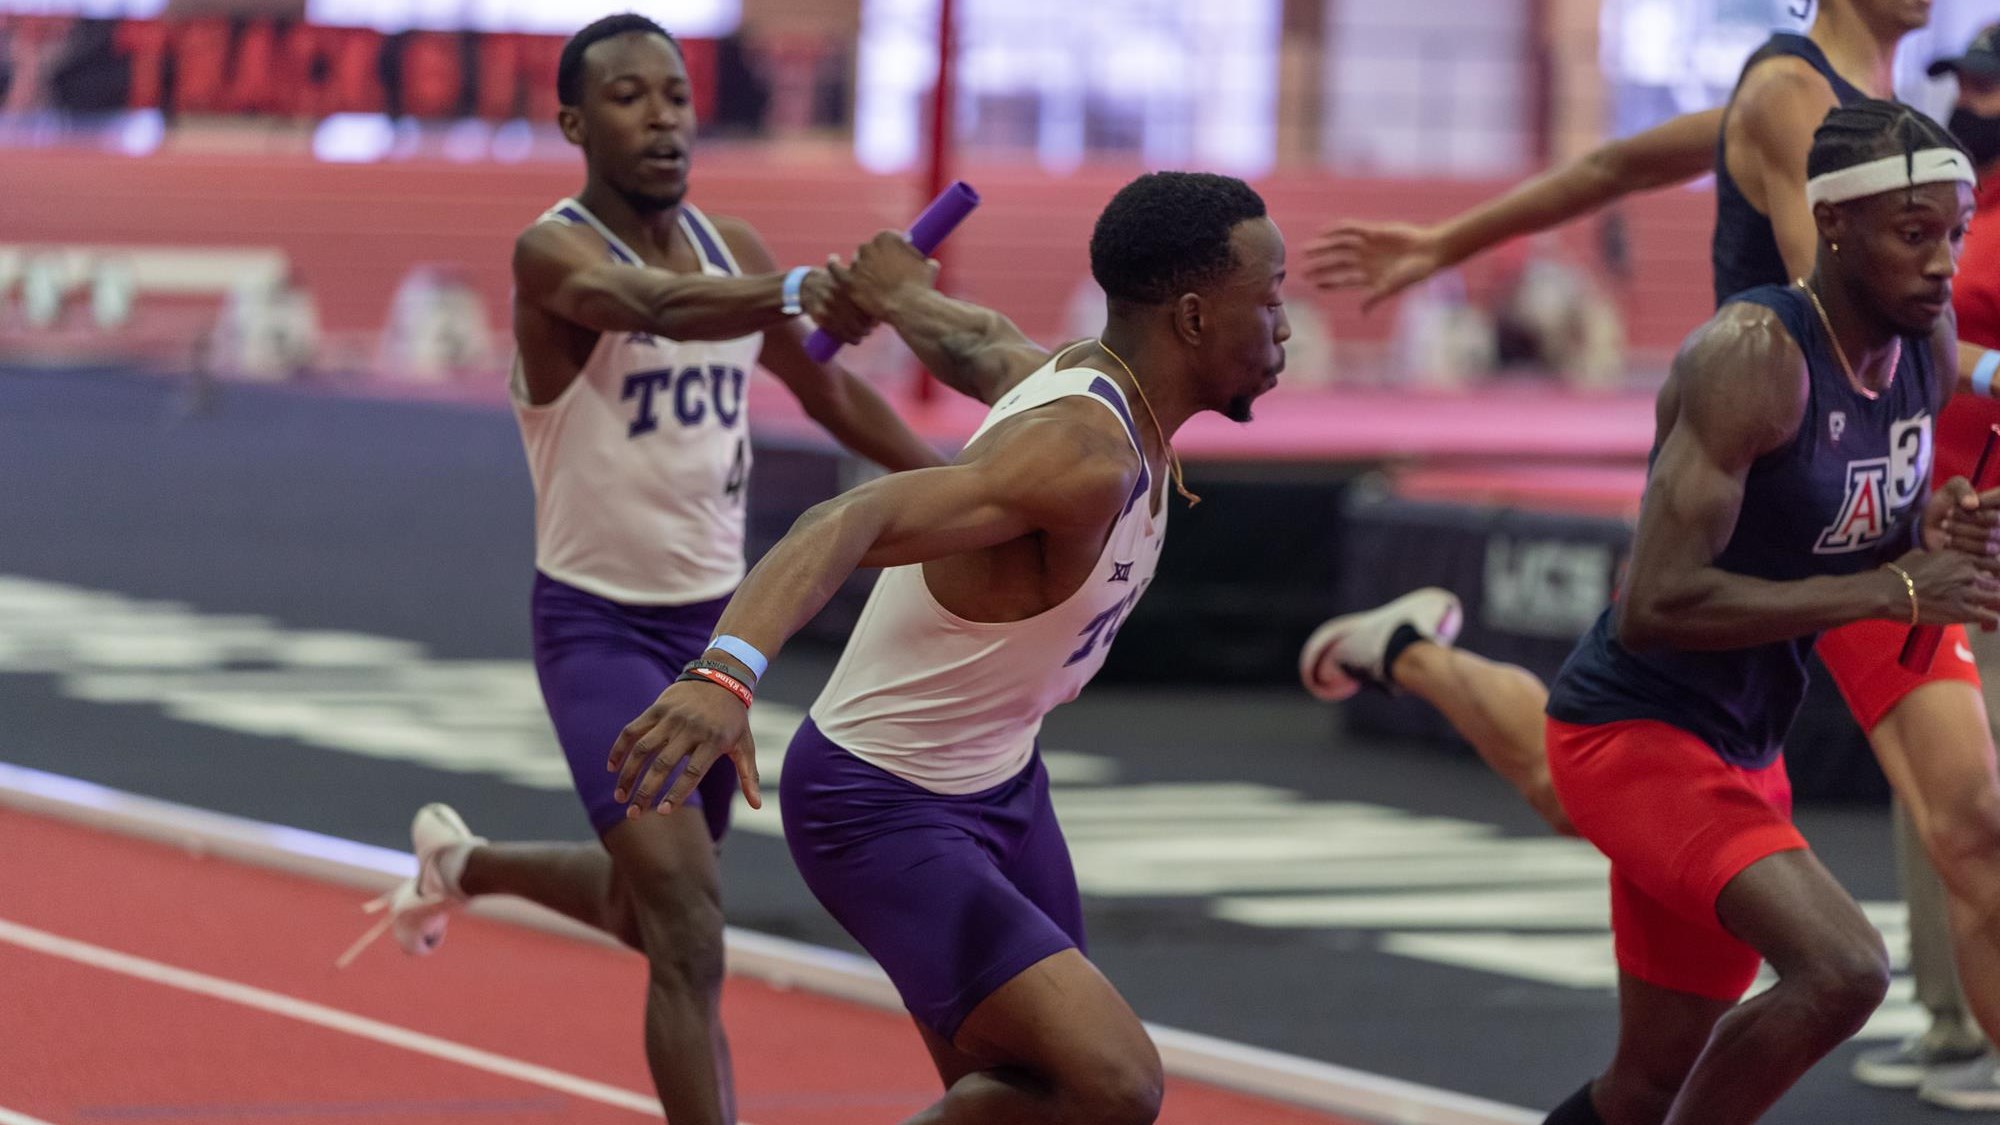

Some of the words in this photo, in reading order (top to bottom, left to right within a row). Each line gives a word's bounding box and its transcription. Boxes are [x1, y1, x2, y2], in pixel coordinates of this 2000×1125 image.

[620, 365, 744, 438] TCU
[725, 437, 744, 502] 4
[1813, 456, 1895, 554] A
[715, 672, 740, 691] Rhino
